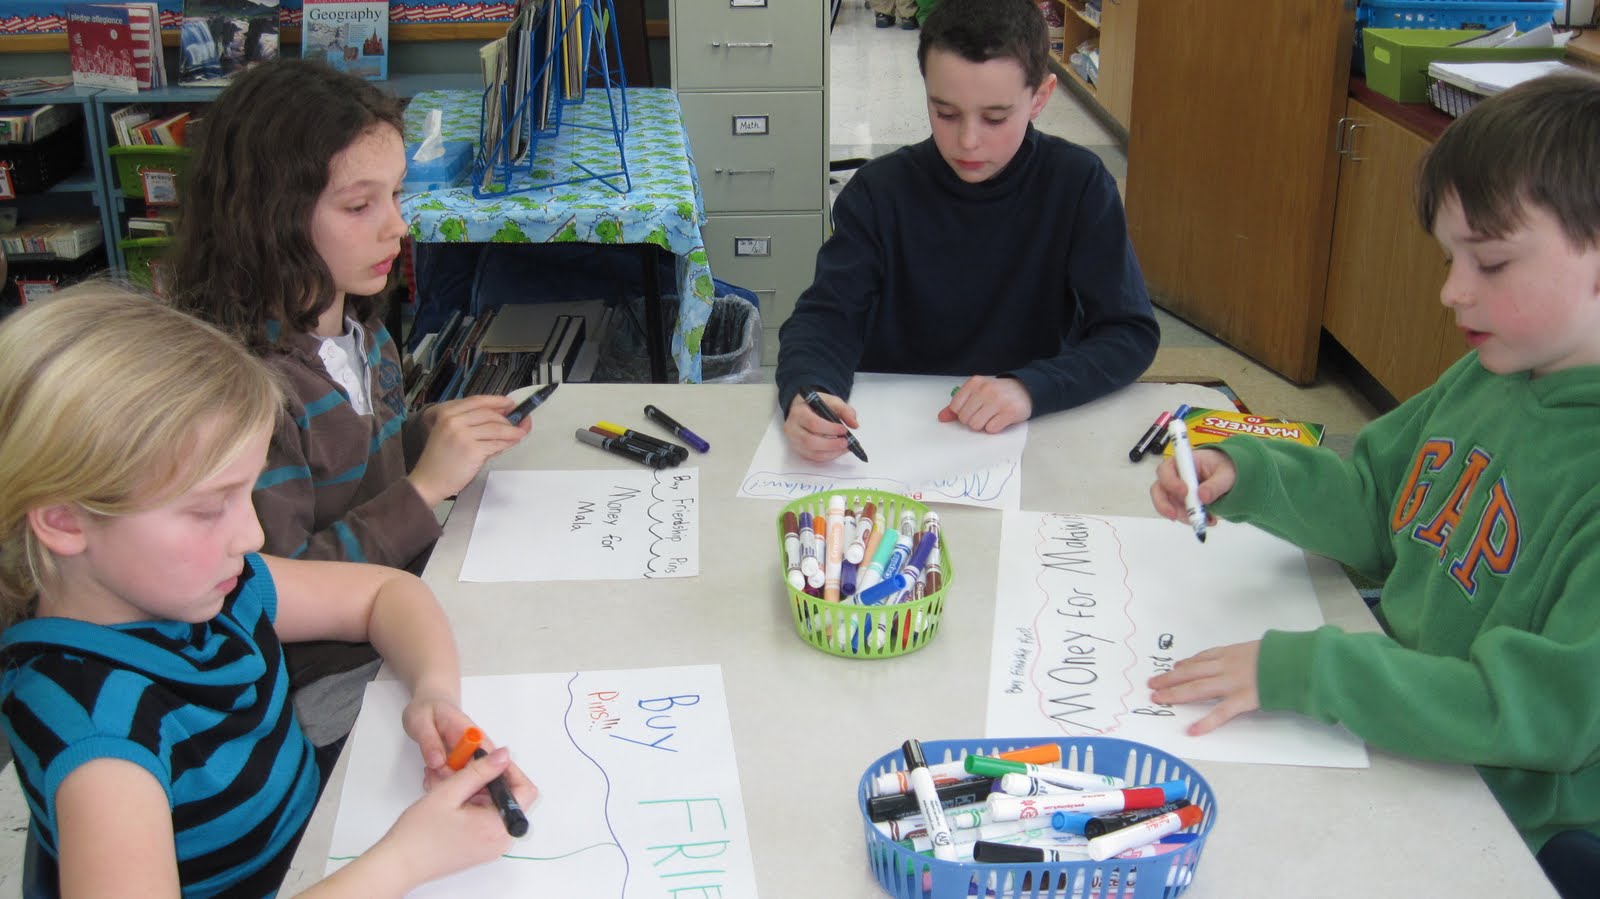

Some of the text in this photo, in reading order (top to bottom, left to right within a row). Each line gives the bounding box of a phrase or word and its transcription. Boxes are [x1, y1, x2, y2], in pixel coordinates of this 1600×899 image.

[71, 14, 91, 24] pledge
[92, 15, 123, 25] allegiance
[309, 7, 382, 22] Geography
[740, 121, 760, 131] Math
[1203, 416, 1300, 438] MARKERS
[1247, 416, 1261, 424] 10
[570, 500, 596, 532] Mala
[601, 485, 642, 550] Money for
[664, 474, 694, 574] Buy Friendship Pins
[1390, 437, 1521, 598] GAP
[883, 552, 901, 579] Crayola
